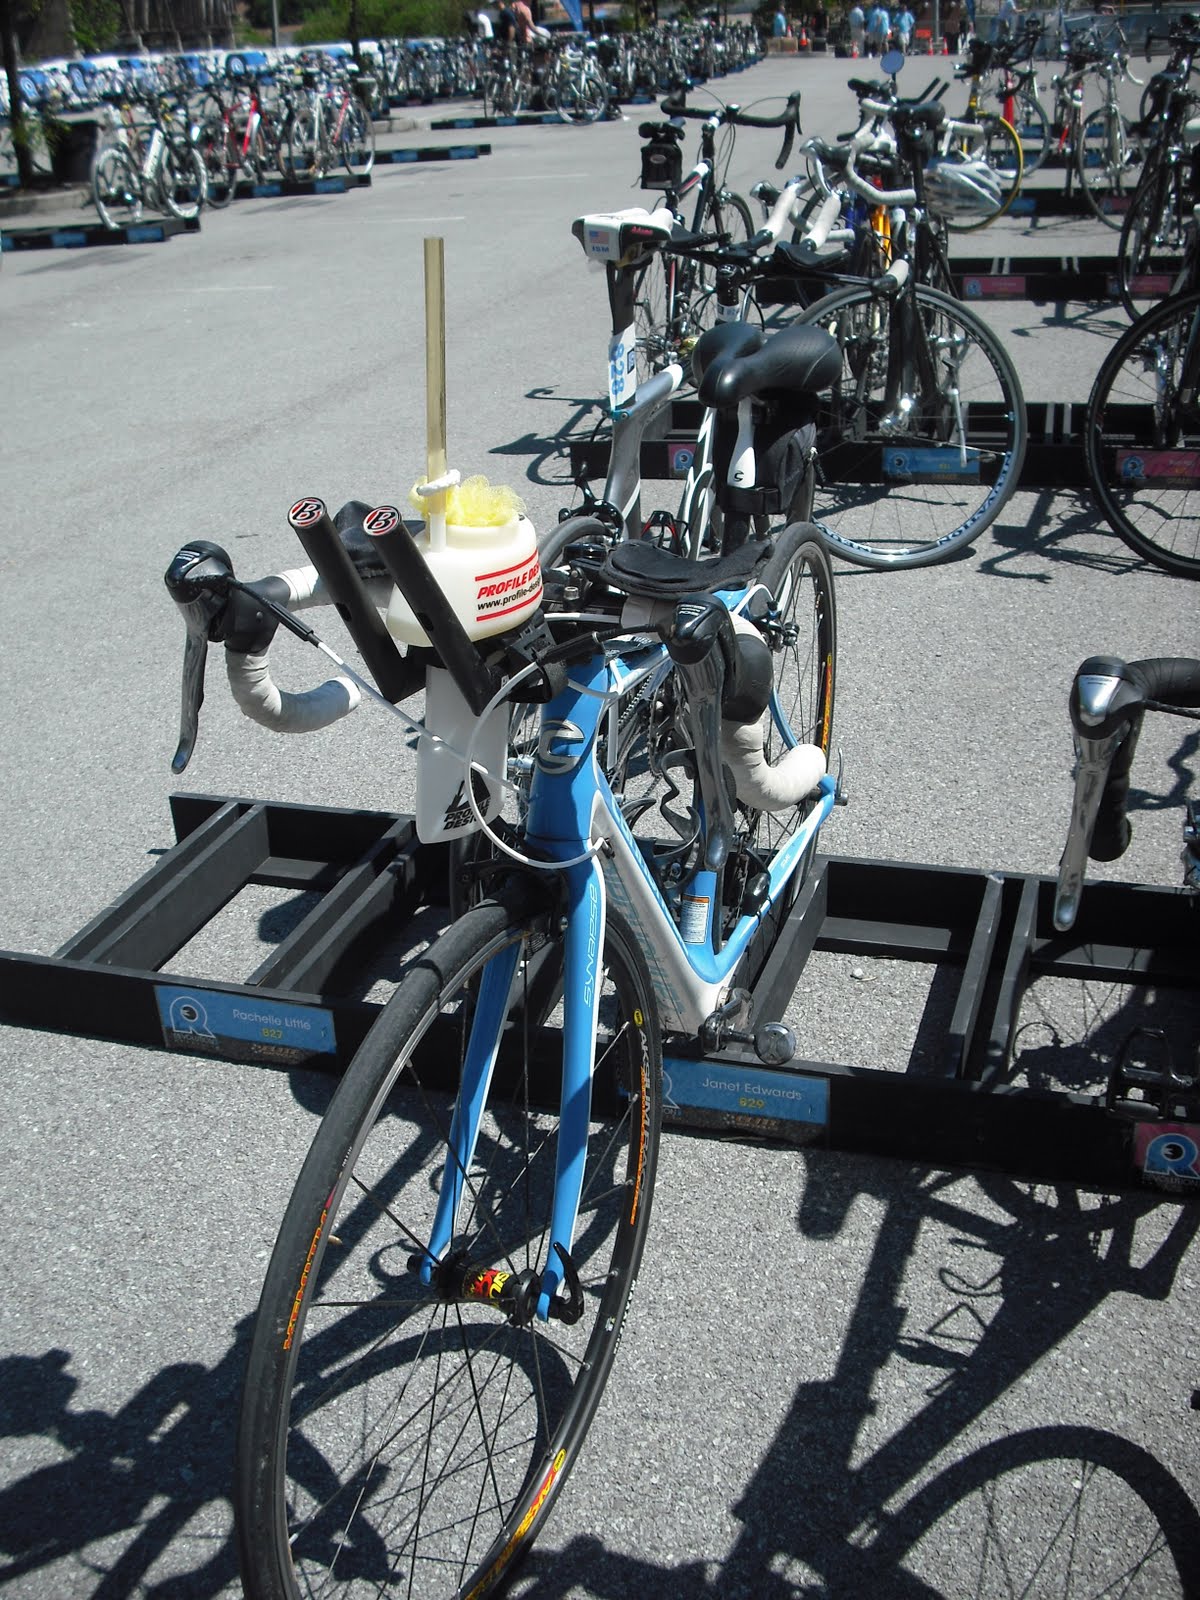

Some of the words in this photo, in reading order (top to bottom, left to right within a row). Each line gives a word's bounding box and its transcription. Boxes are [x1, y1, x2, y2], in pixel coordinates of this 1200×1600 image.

[477, 571, 529, 599] PROFILE
[443, 799, 491, 823] PROILE
[443, 807, 488, 831] DESIN
[232, 1008, 282, 1026] Rachelle
[284, 1017, 312, 1030] Little
[262, 1028, 283, 1040] 827
[702, 1077, 740, 1092] Janet
[744, 1083, 802, 1100] Edwards
